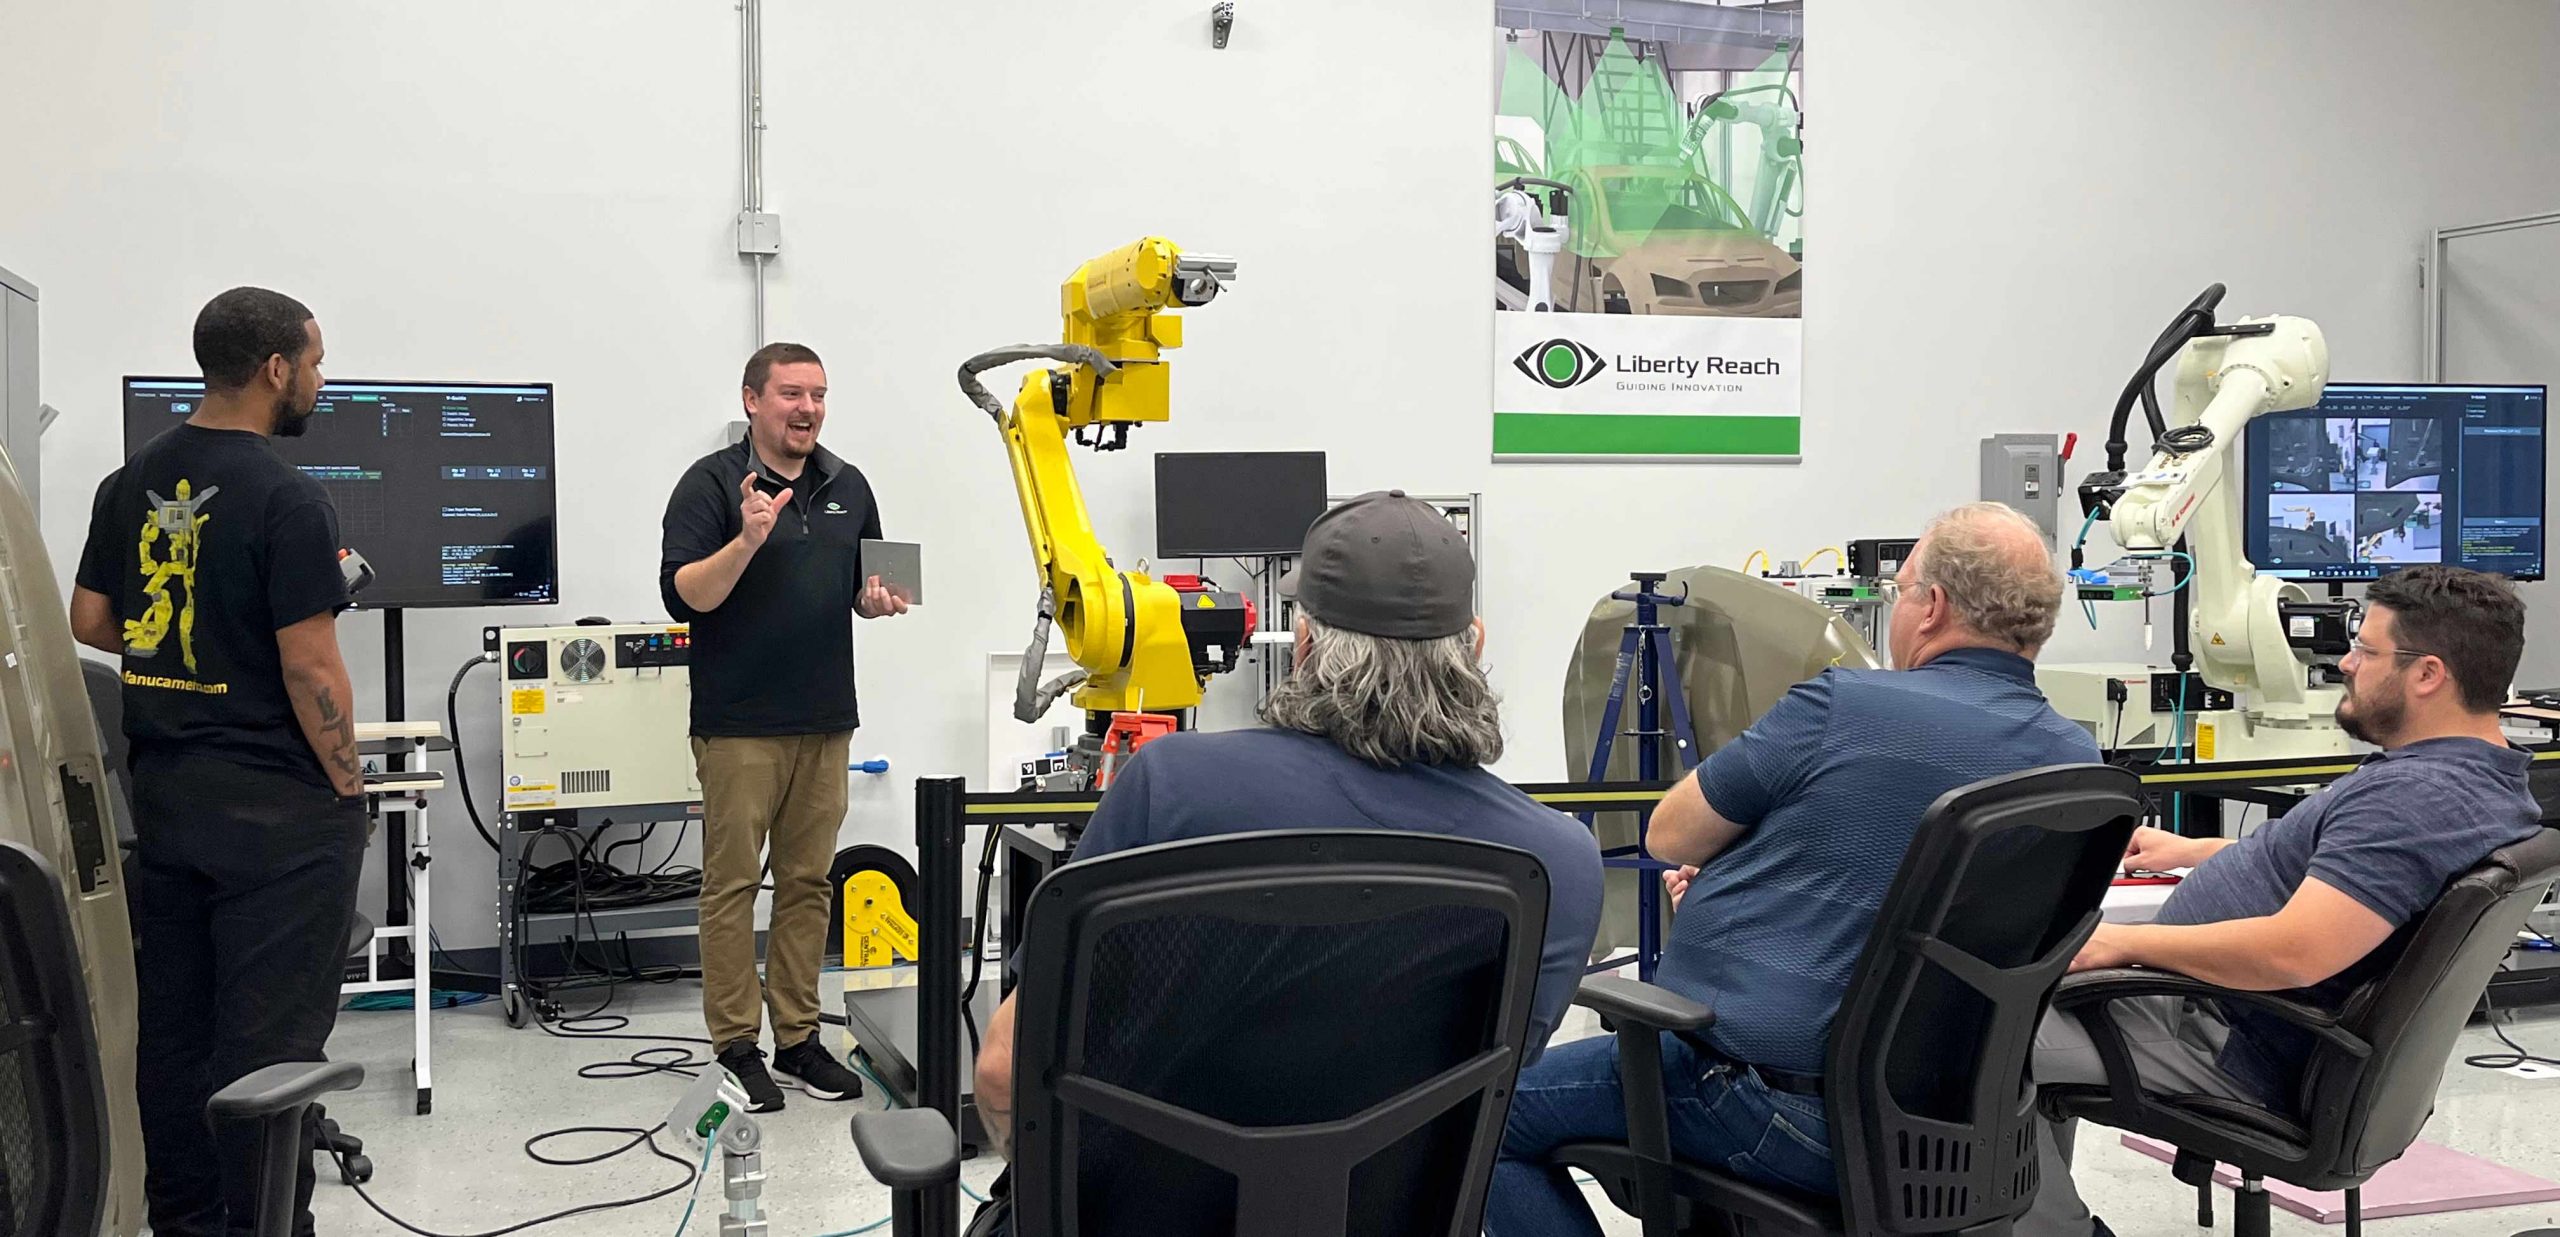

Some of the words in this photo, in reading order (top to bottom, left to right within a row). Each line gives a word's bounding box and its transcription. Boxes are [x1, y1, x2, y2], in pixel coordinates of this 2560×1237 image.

[1616, 355, 1699, 379] Liberty
[1707, 357, 1780, 375] Reach
[1671, 383, 1743, 392] INNOVATION
